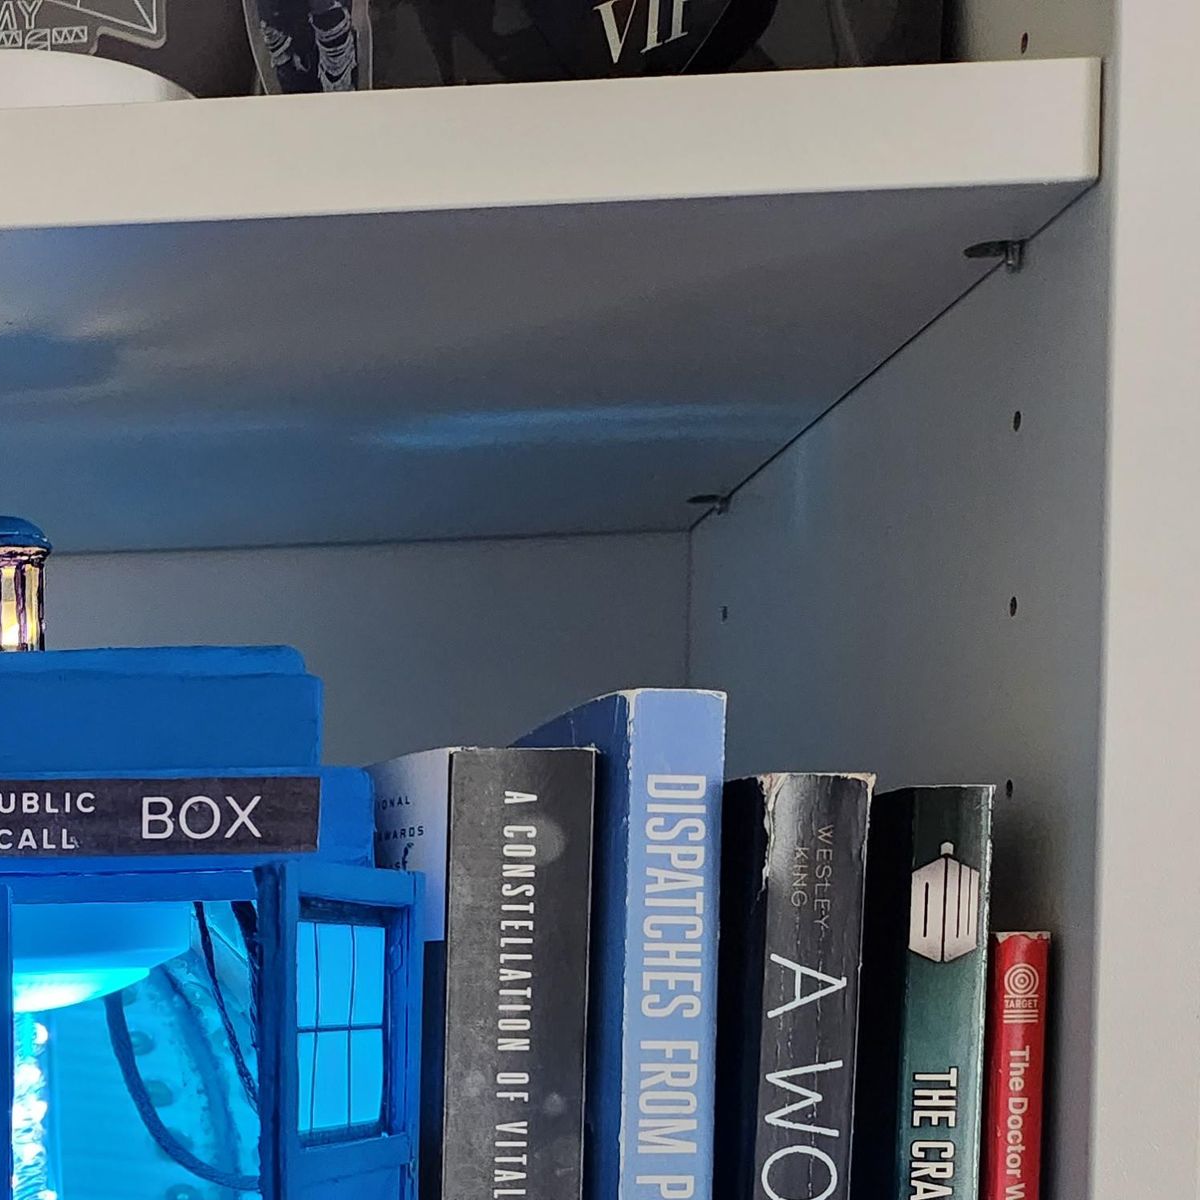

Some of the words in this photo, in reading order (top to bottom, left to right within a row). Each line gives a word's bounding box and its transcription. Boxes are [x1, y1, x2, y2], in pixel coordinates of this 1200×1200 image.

[142, 795, 262, 840] BOX
[504, 790, 538, 804] A
[641, 774, 707, 1019] DISPATCHES
[792, 846, 810, 908] KING
[814, 824, 835, 930] WESLEY
[497, 824, 537, 1052] CONSTELLATION
[767, 952, 848, 1019] A
[1004, 1000, 1039, 1009] TARGET
[495, 1072, 530, 1103] OF
[638, 1040, 699, 1154] FROM
[912, 1067, 959, 1129] THE
[1009, 1045, 1030, 1093] The
[493, 1121, 528, 1199] VITAL
[1005, 1097, 1029, 1179] Doctor
